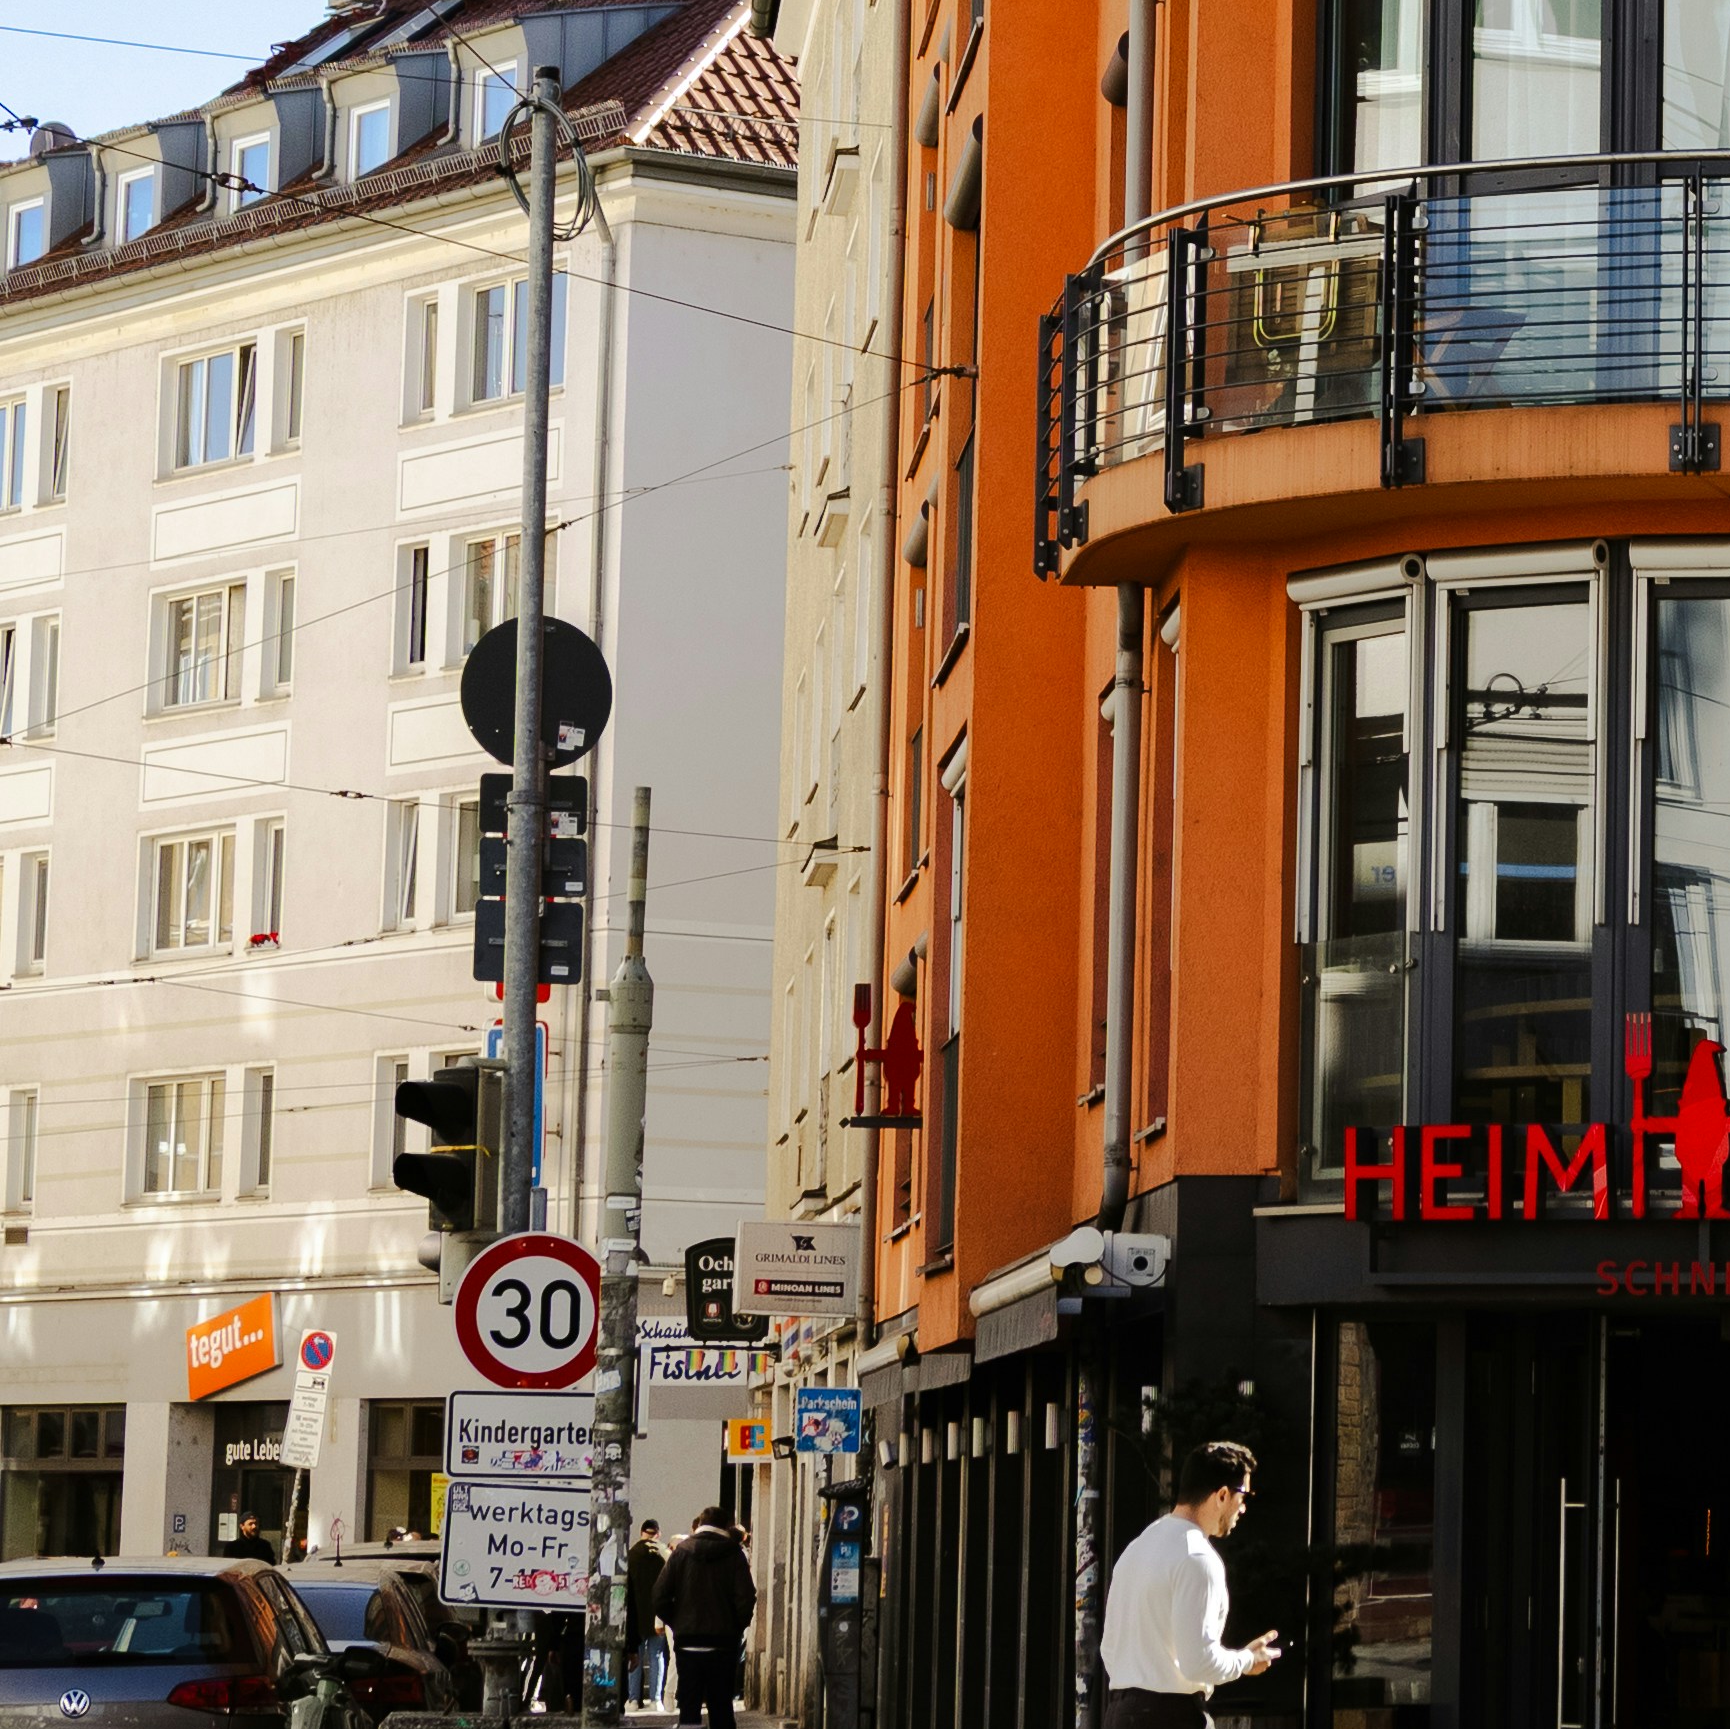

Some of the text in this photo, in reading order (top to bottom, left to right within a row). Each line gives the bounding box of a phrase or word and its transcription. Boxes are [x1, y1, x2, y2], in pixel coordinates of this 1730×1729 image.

[1343, 1122, 1608, 1222] HEIM
[755, 1252, 846, 1266] GRIMALDI LINES
[770, 1283, 842, 1294] MINOAN LINES
[489, 1278, 581, 1350] 30
[190, 1314, 264, 1369] tegut...
[800, 1395, 858, 1411] Parkschein
[225, 1440, 251, 1466] gute
[470, 1501, 591, 1532] werktags
[487, 1532, 569, 1559] Mo-Fr
